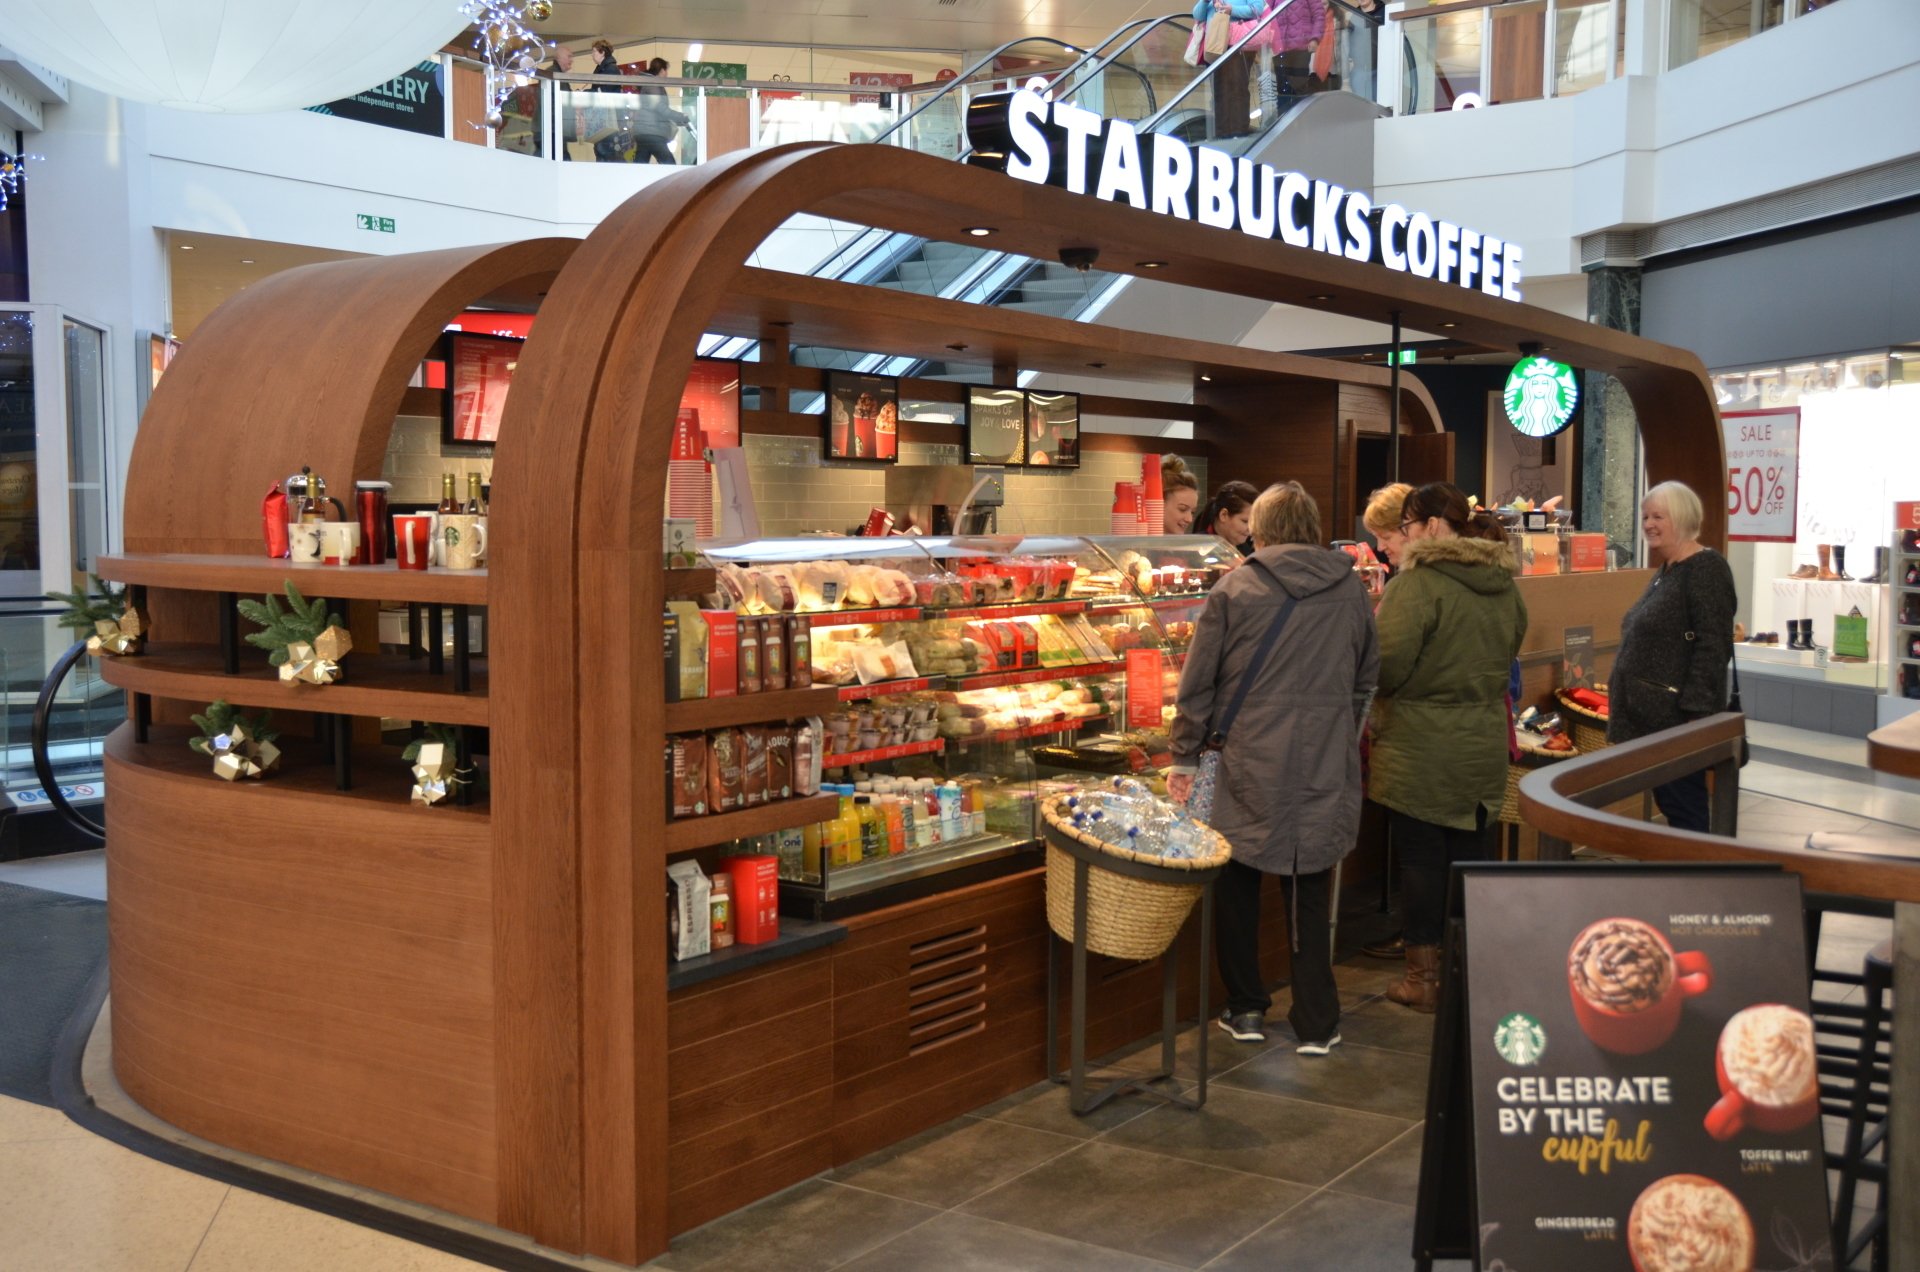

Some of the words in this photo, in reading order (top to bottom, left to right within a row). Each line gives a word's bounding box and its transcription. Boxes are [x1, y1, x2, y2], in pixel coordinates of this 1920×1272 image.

[357, 95, 395, 110] independent
[395, 103, 414, 113] stores
[1007, 88, 1371, 263] STARBUCKS
[1380, 203, 1523, 302] COFFEE
[975, 405, 1001, 415] SPARKS
[1002, 406, 1013, 415] OF
[981, 417, 995, 428] JOY
[1002, 419, 1020, 430] LOVE
[1741, 425, 1772, 442] SALE
[1728, 466, 1785, 516] 50%
[1765, 501, 1784, 515] OFF
[1669, 914, 1708, 925] HONEY
[1711, 914, 1719, 925] &
[1723, 914, 1771, 926] ALMOND
[1671, 926, 1692, 935] HOT
[1695, 927, 1761, 936] CHOCOLATE
[1497, 1076, 1671, 1104] CELEBRATE
[1499, 1108, 1537, 1135] BY
[1544, 1108, 1606, 1135] THE
[1542, 1119, 1653, 1174] cupful
[1740, 1149, 1782, 1161] TOFFEE
[1785, 1150, 1809, 1161] NUT
[1535, 1217, 1615, 1229] GINGERBREAD
